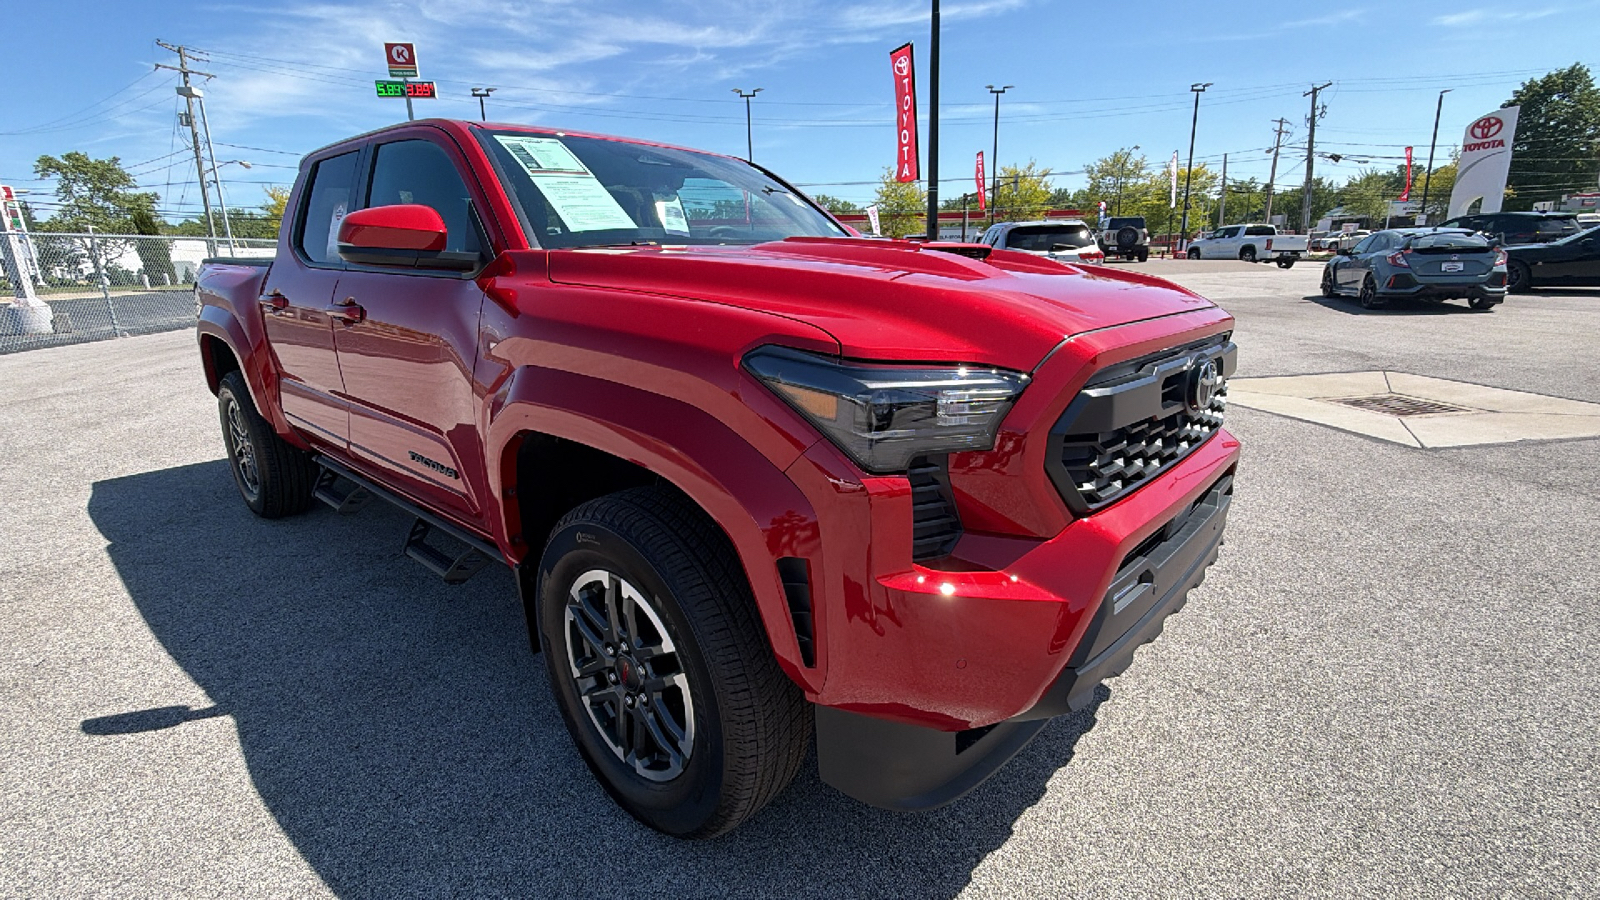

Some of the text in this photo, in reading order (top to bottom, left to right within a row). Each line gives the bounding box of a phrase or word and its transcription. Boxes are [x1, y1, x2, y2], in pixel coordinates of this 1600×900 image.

[901, 78, 911, 178] TOYOTA
[1463, 139, 1505, 152] TOYOTA
[408, 450, 460, 480] TACOMA
